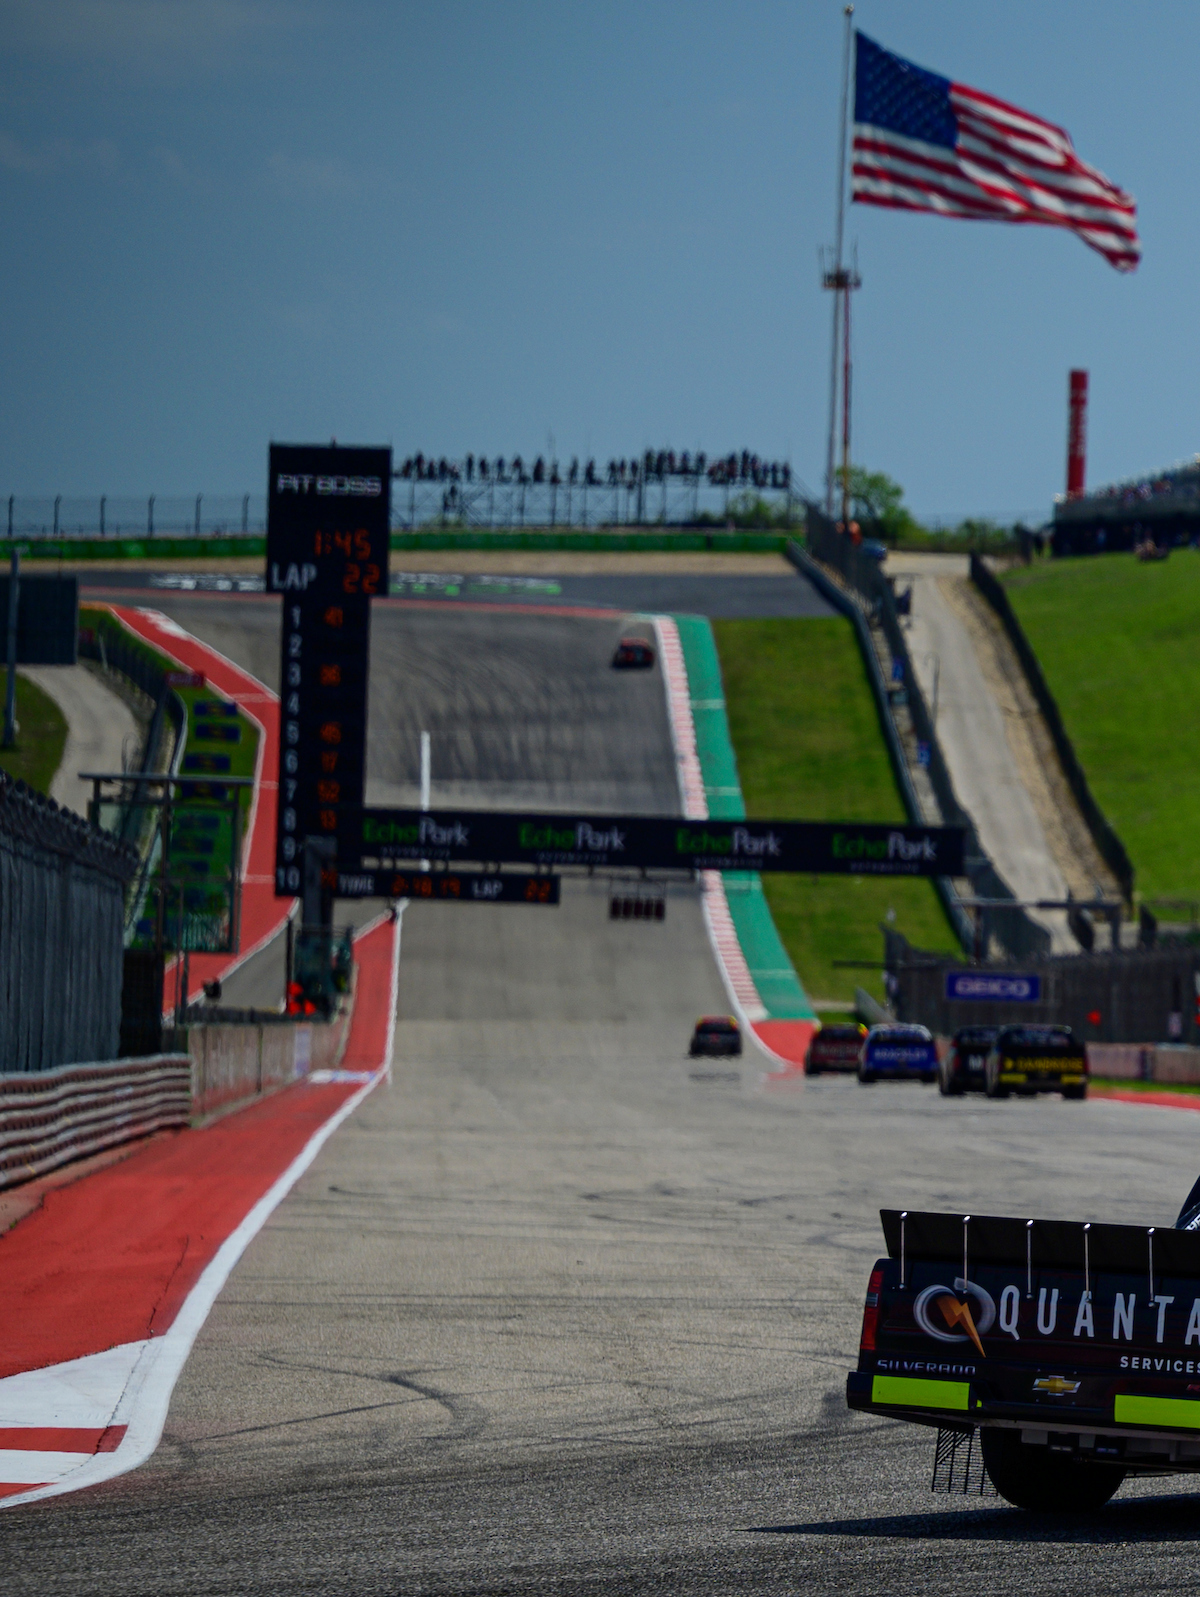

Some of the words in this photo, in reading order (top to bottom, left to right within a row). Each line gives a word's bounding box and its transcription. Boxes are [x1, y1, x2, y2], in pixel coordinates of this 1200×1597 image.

[314, 528, 371, 560] 1:45
[271, 562, 318, 591] LAP
[342, 562, 380, 594] 22
[291, 605, 301, 628] 1
[289, 633, 302, 657] 2
[287, 662, 301, 687] 3
[287, 691, 299, 716] 4
[286, 720, 300, 745] 5
[285, 748, 298, 774] 6
[285, 778, 297, 802] 7
[283, 836, 296, 861] 9
[277, 866, 300, 890] 10
[338, 874, 374, 894] TIME
[472, 879, 502, 898] LAP
[954, 978, 1031, 998] GEICO
